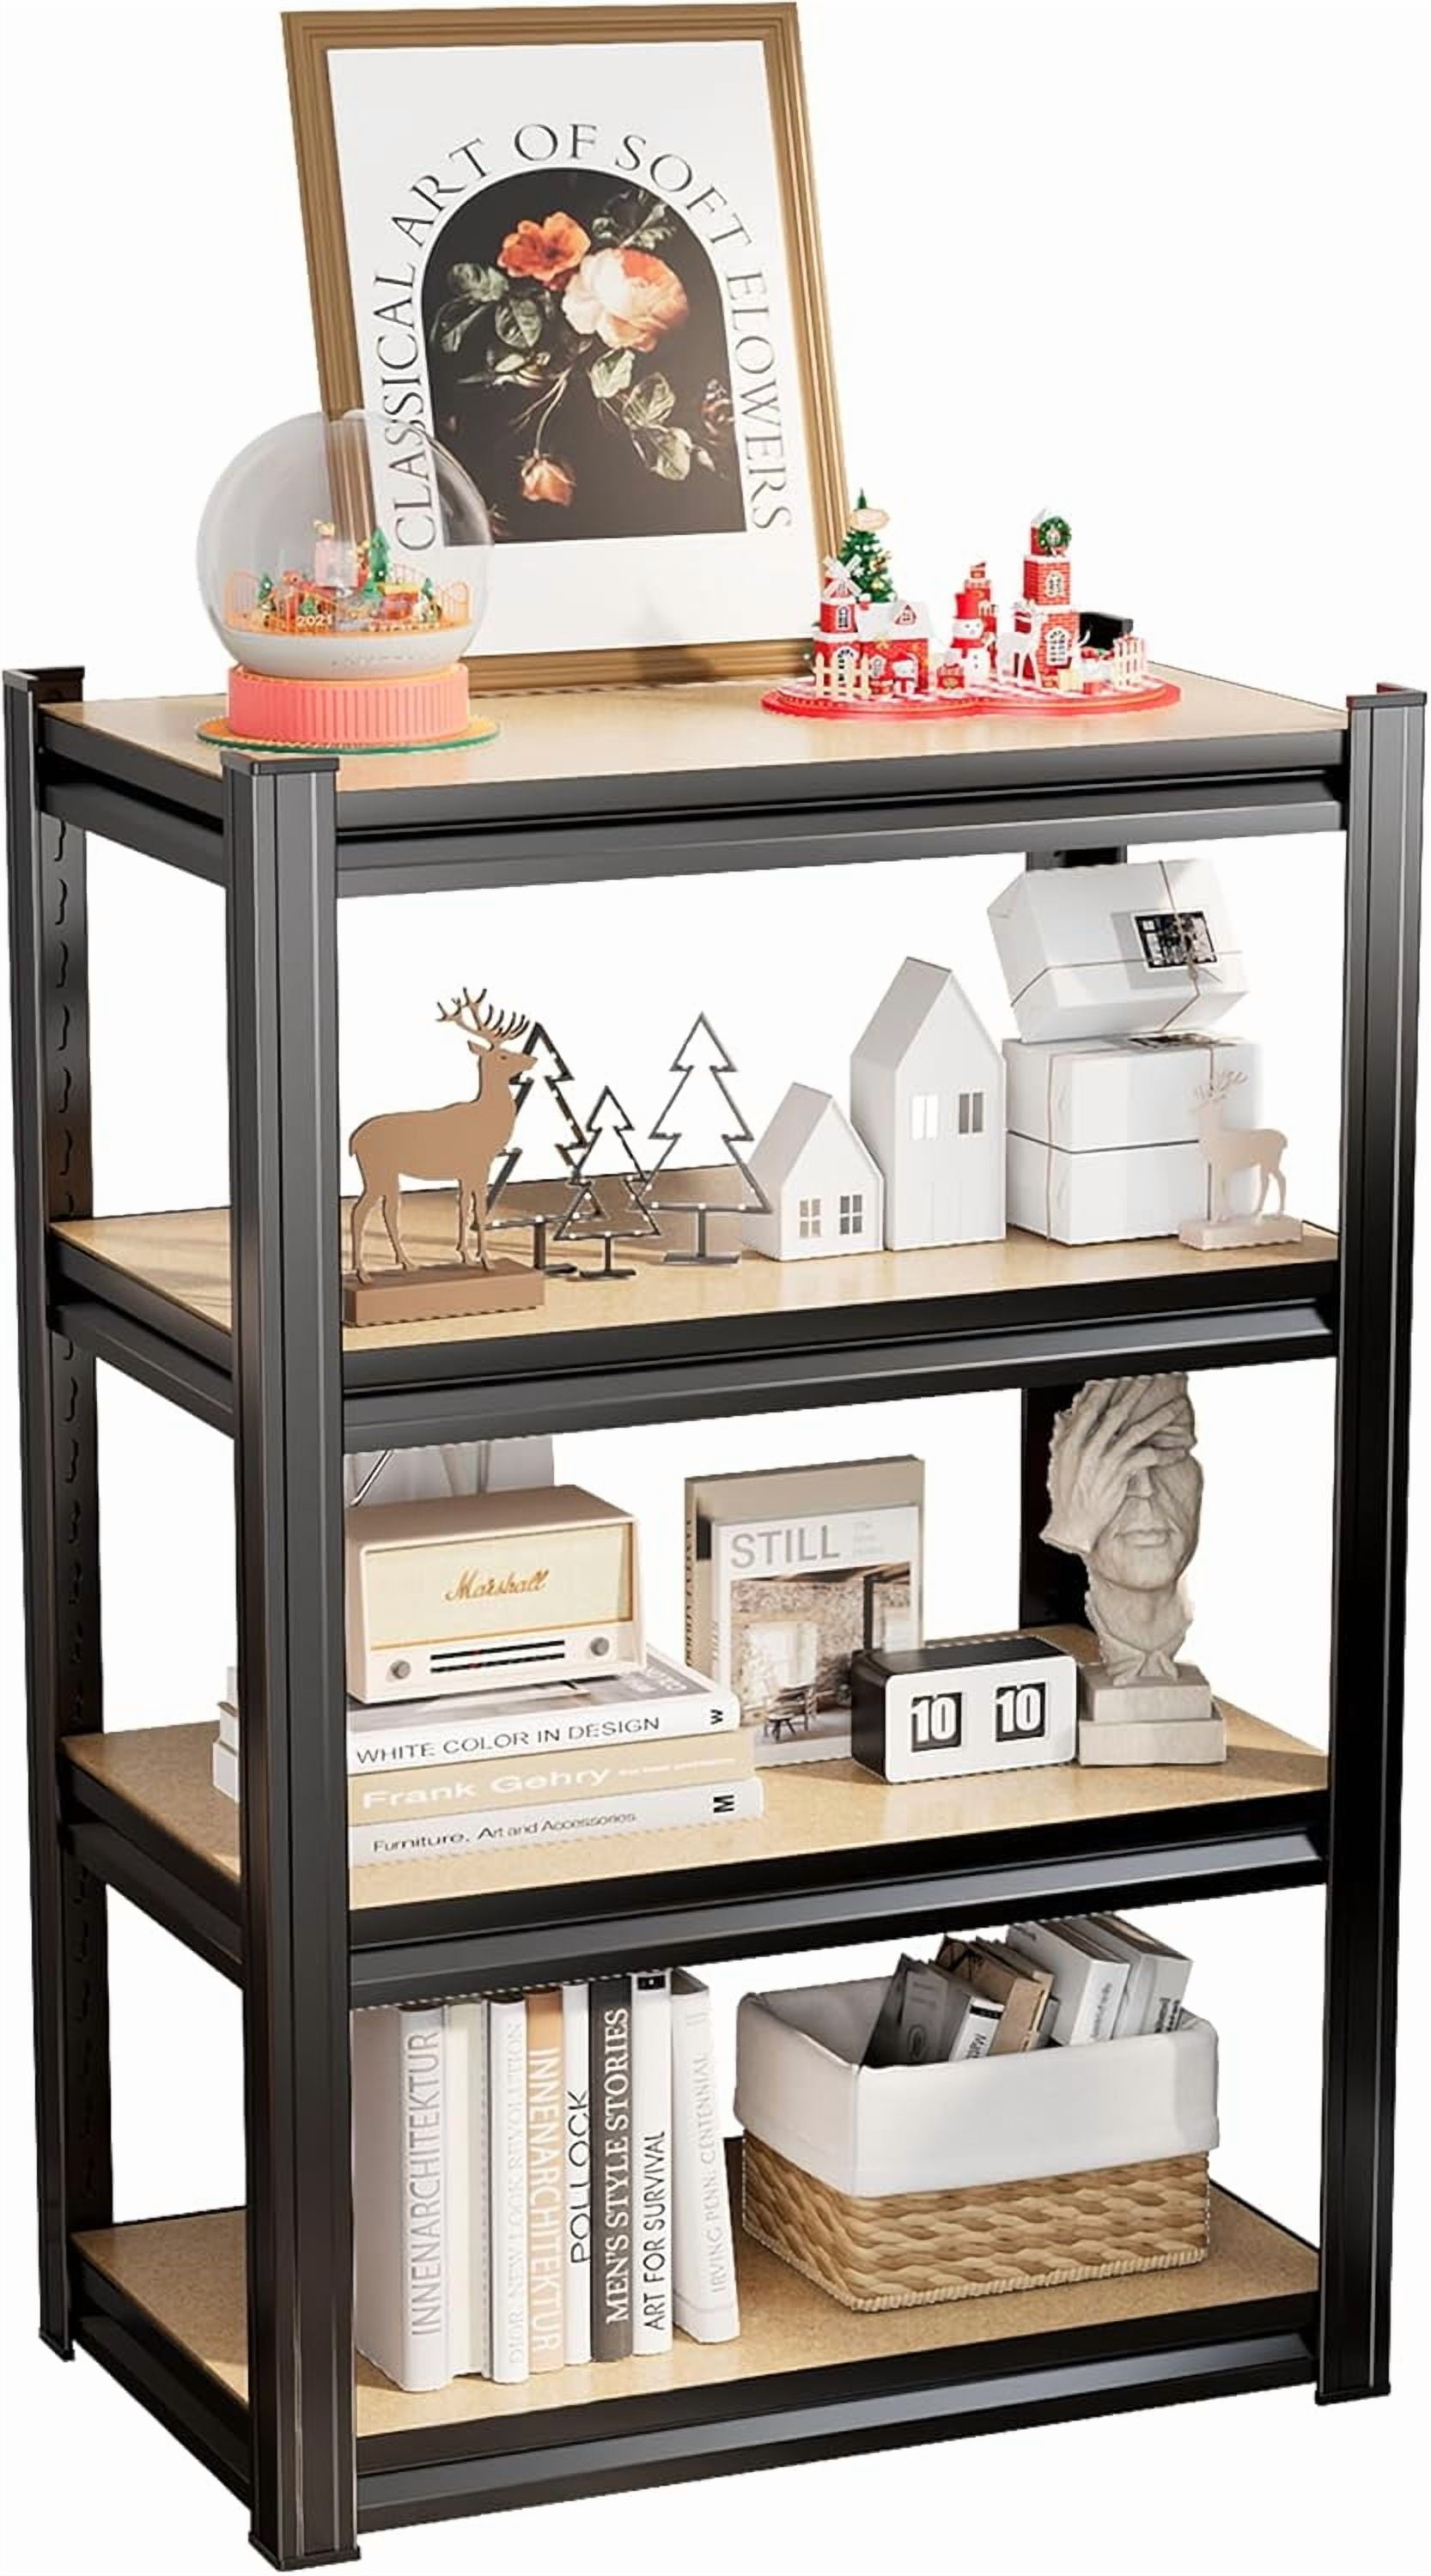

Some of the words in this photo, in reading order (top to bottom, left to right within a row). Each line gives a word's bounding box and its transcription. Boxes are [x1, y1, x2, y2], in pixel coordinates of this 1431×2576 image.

[514, 124, 600, 161] OF
[390, 138, 487, 247] ART
[613, 134, 752, 249] SOFT
[374, 263, 437, 551] CLASSICAL
[730, 1524, 841, 1569] STILL
[445, 1567, 550, 1601] Marshall
[911, 1697, 957, 1742] 10
[996, 1687, 1041, 1732] 10
[356, 1742, 435, 1764] WHITE
[442, 1731, 530, 1754] COLOR
[538, 1728, 560, 1743] IN
[568, 1716, 660, 1740] DESIGN
[362, 1780, 478, 1809] Frank
[490, 1767, 612, 1794] Gehry
[713, 1794, 735, 1814] M
[477, 1826, 504, 1841] Art
[507, 1822, 539, 1838] and
[604, 2007, 629, 2132] STORIES
[407, 2032, 441, 2336] INNENARCHITEKTUR
[528, 2046, 562, 2351] INNENARCHITEKTUR
[605, 2136, 629, 2228] STYLE
[643, 2130, 667, 2231] SURVIVAL
[605, 2233, 630, 2324] MEN'S
[642, 2237, 666, 2283] FOR
[643, 2292, 666, 2330] ART
